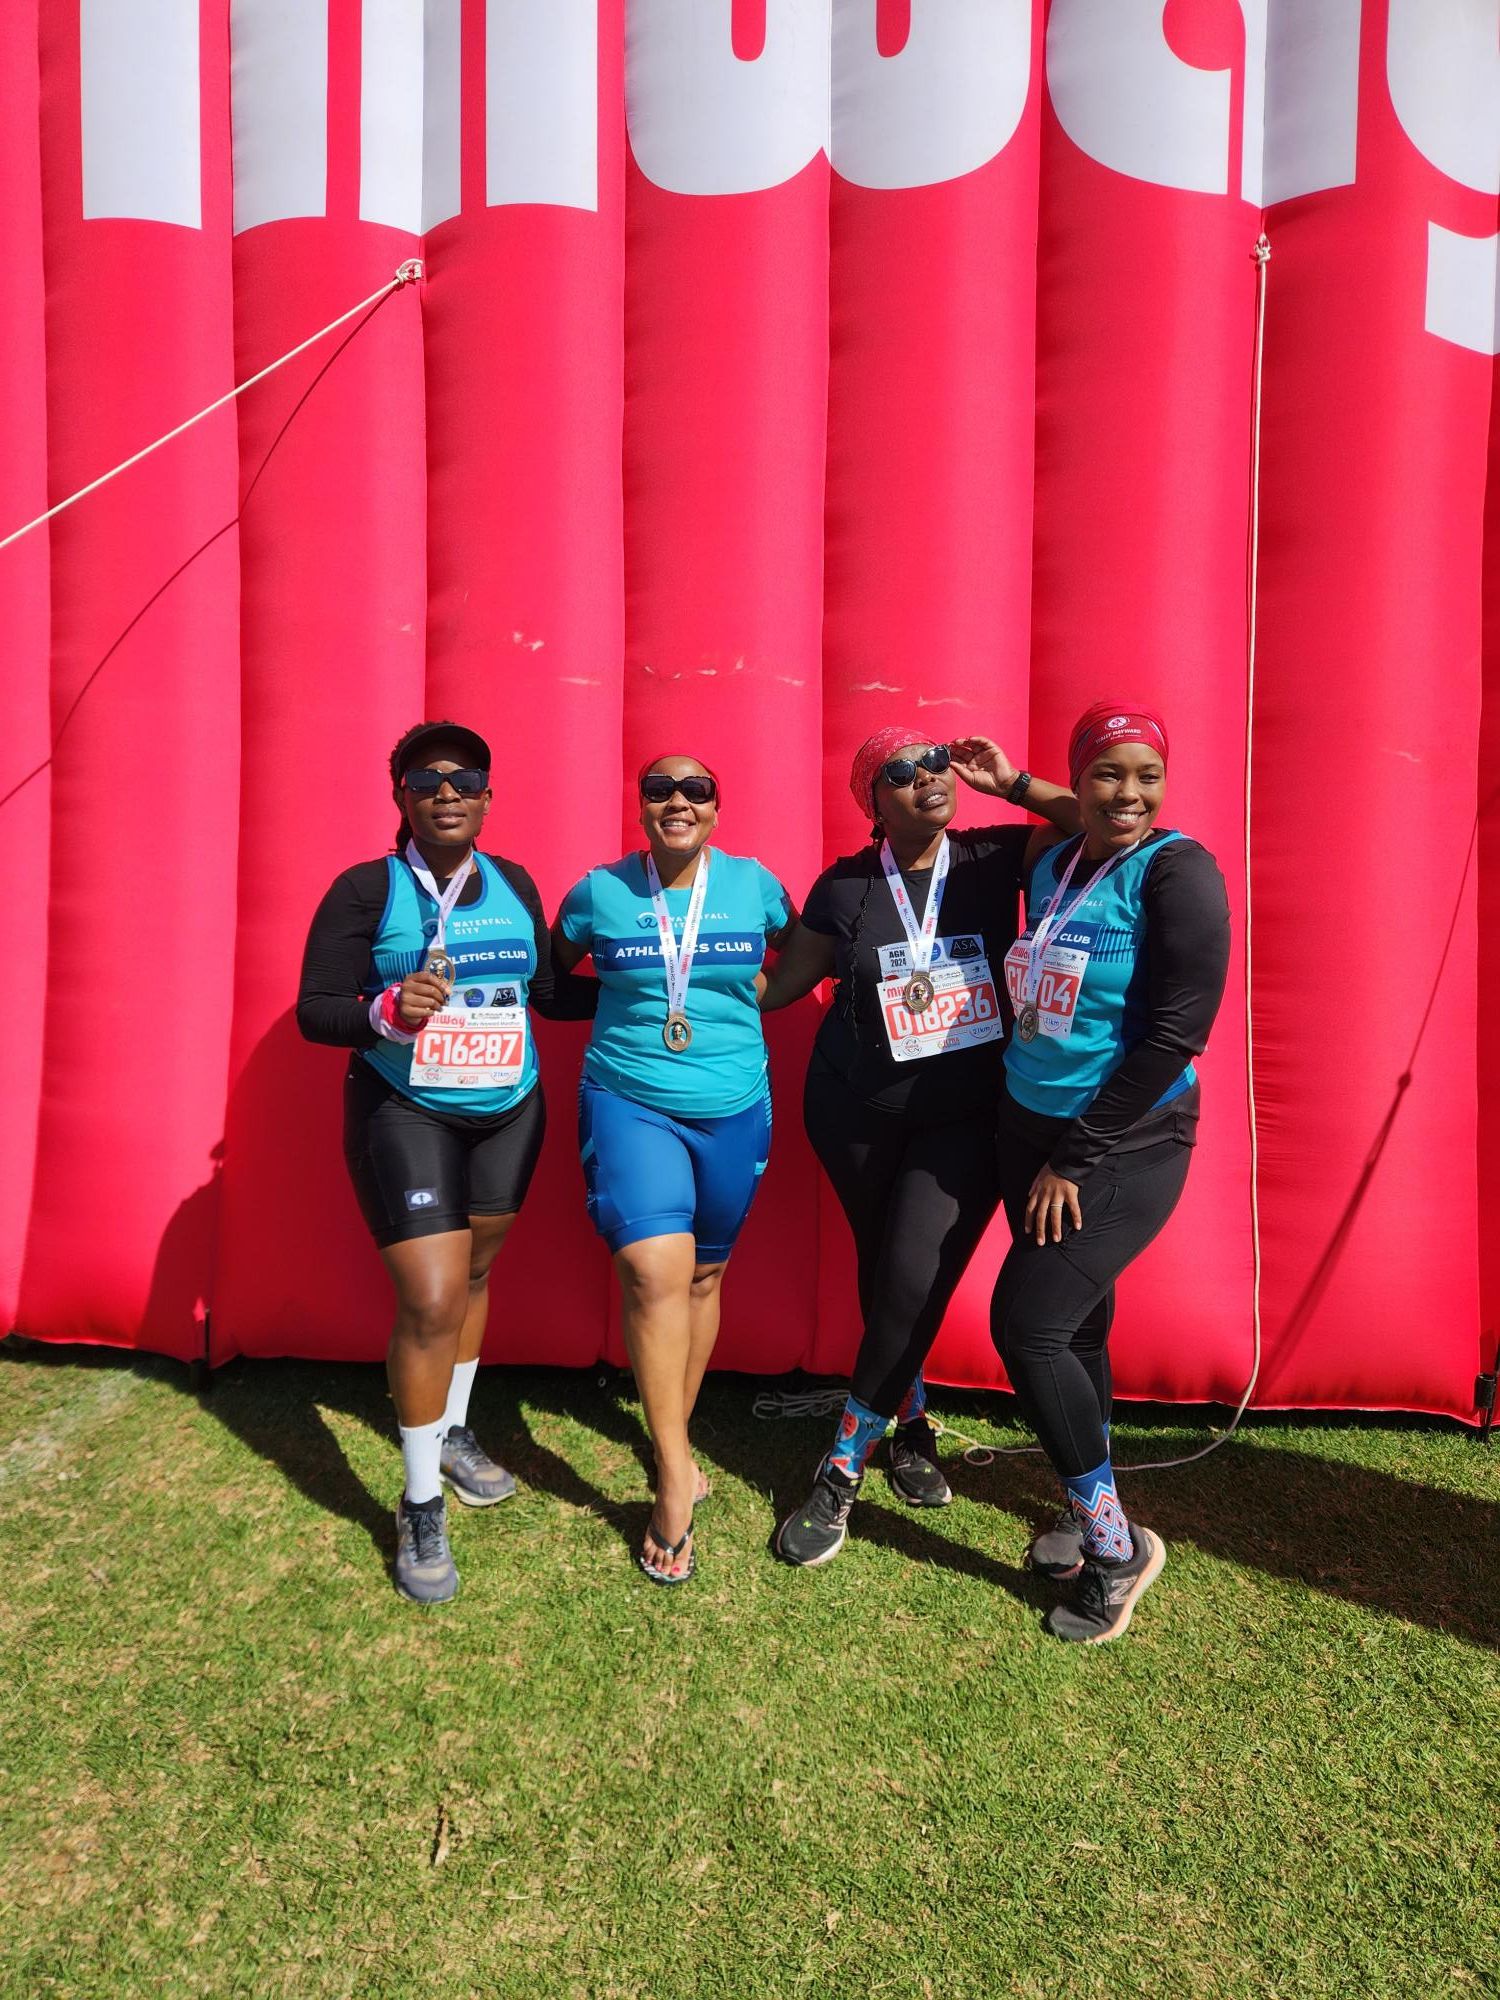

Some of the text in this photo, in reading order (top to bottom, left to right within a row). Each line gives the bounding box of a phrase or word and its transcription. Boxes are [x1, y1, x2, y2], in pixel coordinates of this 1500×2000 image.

[452, 917, 513, 928] WATERFALL
[454, 927, 480, 935] CITY
[953, 939, 977, 949] ASA
[1059, 932, 1091, 944] CLUB
[498, 950, 528, 960] CLUB
[615, 942, 710, 959] ATHLS
[714, 941, 753, 953] CLUB
[890, 958, 907, 967] 2024
[496, 988, 515, 1000] ASA
[1007, 965, 1072, 1013] C1604
[891, 987, 993, 1037] D18236
[422, 1033, 518, 1065] C16287
